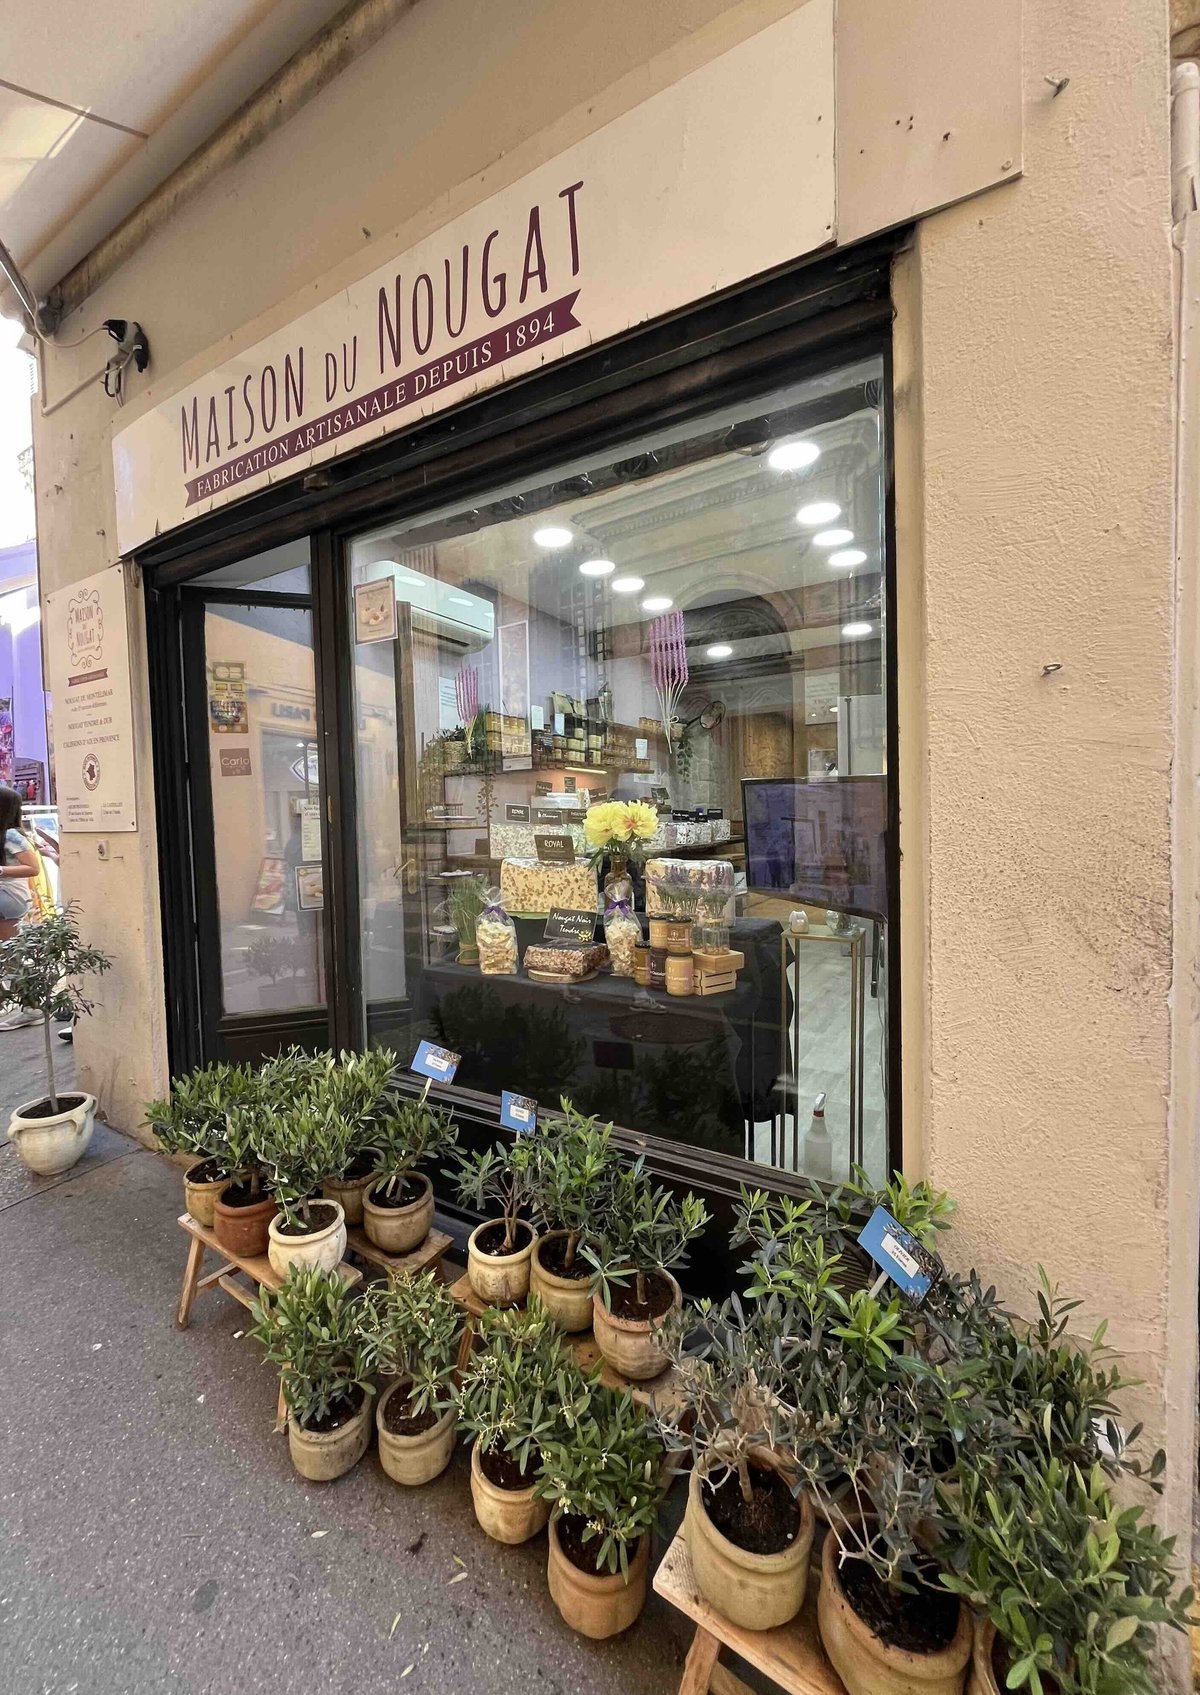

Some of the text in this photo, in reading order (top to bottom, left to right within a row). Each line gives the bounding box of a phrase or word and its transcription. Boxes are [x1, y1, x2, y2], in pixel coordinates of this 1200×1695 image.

[181, 180, 584, 474] MAISON DU NOUGAT
[196, 311, 556, 498] FABRICATION ARTISANALE DEPUIS 1894
[221, 757, 250, 766] Carlo
[544, 839, 564, 848] ROYAL
[552, 912, 576, 924] Nougat
[560, 924, 580, 935] Tendre
